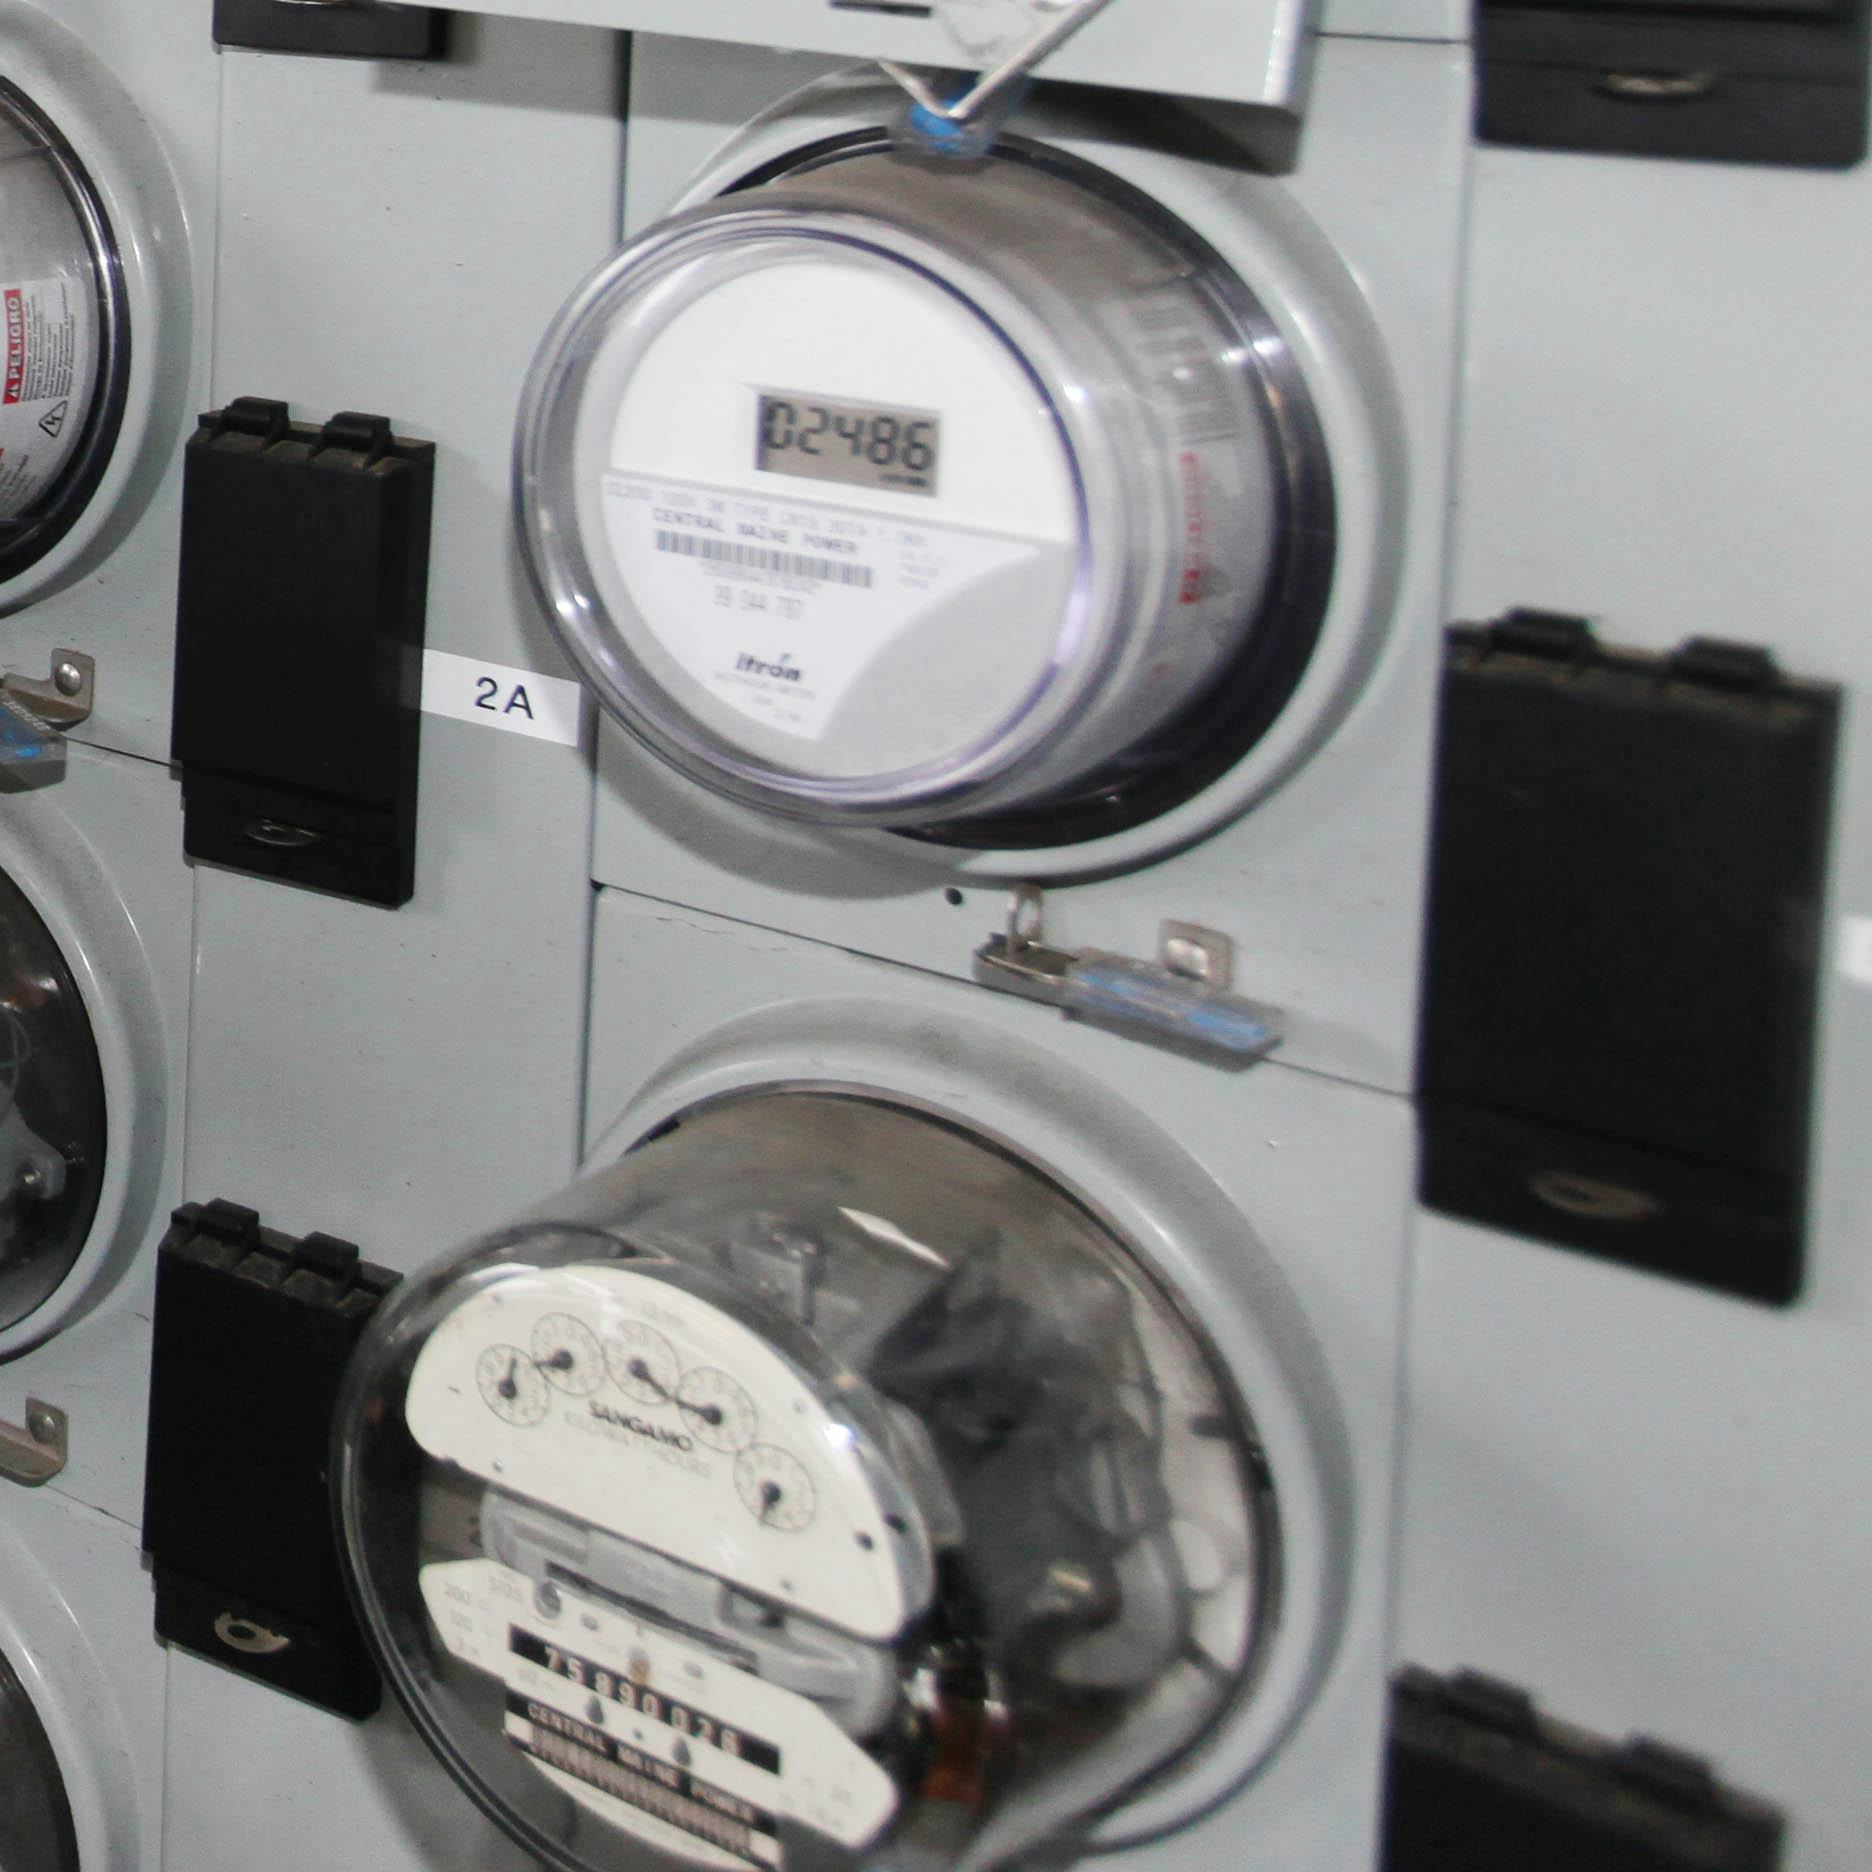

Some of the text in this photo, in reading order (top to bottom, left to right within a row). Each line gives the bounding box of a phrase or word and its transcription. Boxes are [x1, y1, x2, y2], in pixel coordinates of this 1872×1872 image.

[7, 296, 25, 379] PELIGRO
[763, 400, 936, 472] 02486
[653, 508, 859, 555] CENTRAL MAINE POWER
[734, 651, 803, 681] Itron
[474, 676, 535, 721] 2A
[588, 1398, 694, 1453] SANGAMO
[527, 1702, 609, 1755] CENTRAL
